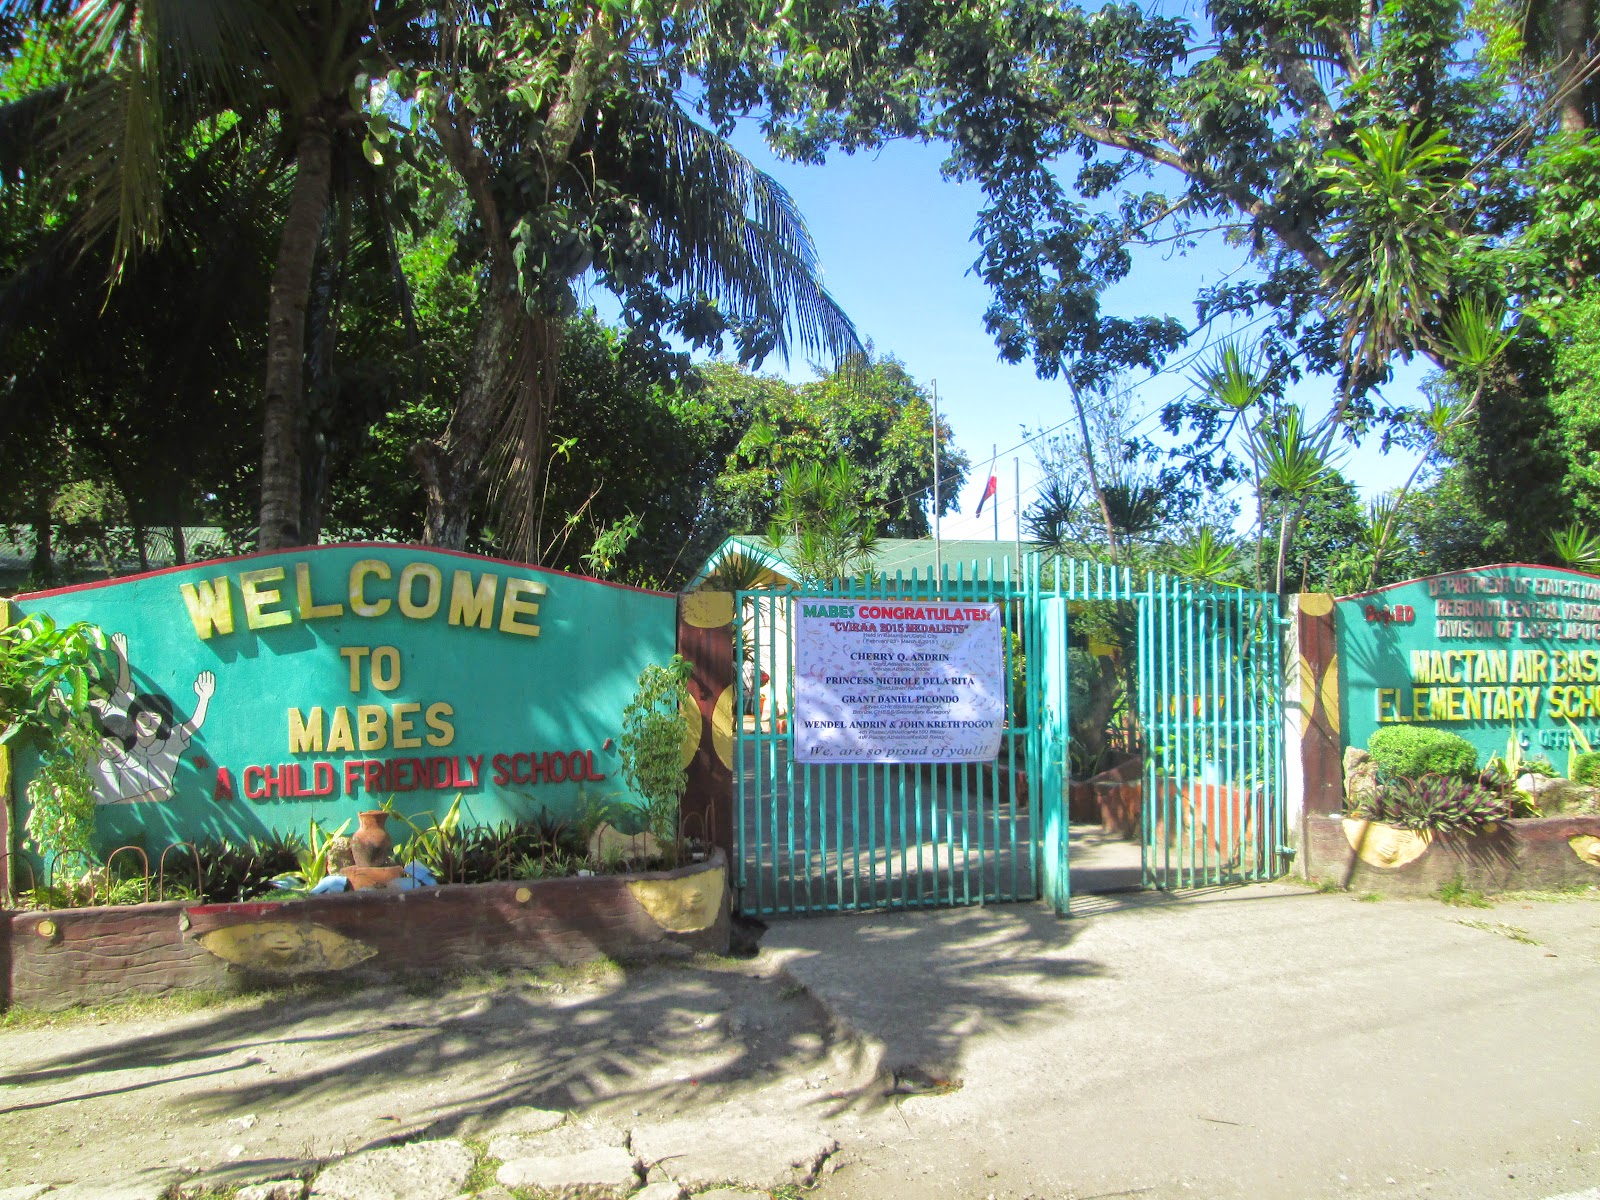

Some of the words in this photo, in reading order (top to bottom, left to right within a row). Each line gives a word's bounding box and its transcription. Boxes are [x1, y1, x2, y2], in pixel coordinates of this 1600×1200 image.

[1429, 576, 1510, 596] DEPARTMENT
[1515, 577, 1531, 594] OF
[180, 559, 547, 639] WELCOME
[803, 605, 855, 618] MABES
[859, 606, 990, 621] CONGRATULATES:
[1436, 599, 1485, 616] REGION
[1505, 600, 1561, 618] CENTRAL
[879, 623, 904, 633] 2015
[1436, 620, 1493, 638] DIVISION
[1498, 620, 1515, 638] OF
[850, 652, 894, 662] CHERRY
[897, 653, 908, 662] Q.
[911, 653, 949, 662] ANDRIN
[1411, 649, 1508, 683] MACTAN
[1510, 649, 1548, 682] AIR
[1550, 649, 1600, 682] BAS
[341, 645, 401, 693] TO
[826, 677, 874, 685] PRINCESS
[877, 677, 920, 685] NICHOLE
[923, 677, 949, 685] DELA
[951, 677, 974, 686] RITA
[841, 695, 876, 704] GRANT
[878, 695, 913, 704] DANIEL
[916, 695, 959, 704] PICONDO
[1375, 686, 1540, 722] ELEMENTARY
[288, 702, 455, 754] MABES
[804, 720, 847, 729] WENDEL
[849, 720, 887, 729] ANDRIN
[889, 720, 895, 729] &
[899, 720, 925, 729] JOHN
[927, 720, 960, 729] KRETH
[962, 720, 994, 729] POGOY
[839, 748, 862, 756] are
[867, 748, 882, 756] so
[885, 745, 928, 758] proud
[931, 745, 947, 758] of
[243, 760, 334, 799] CHILD
[344, 754, 484, 795] FRIENDLY
